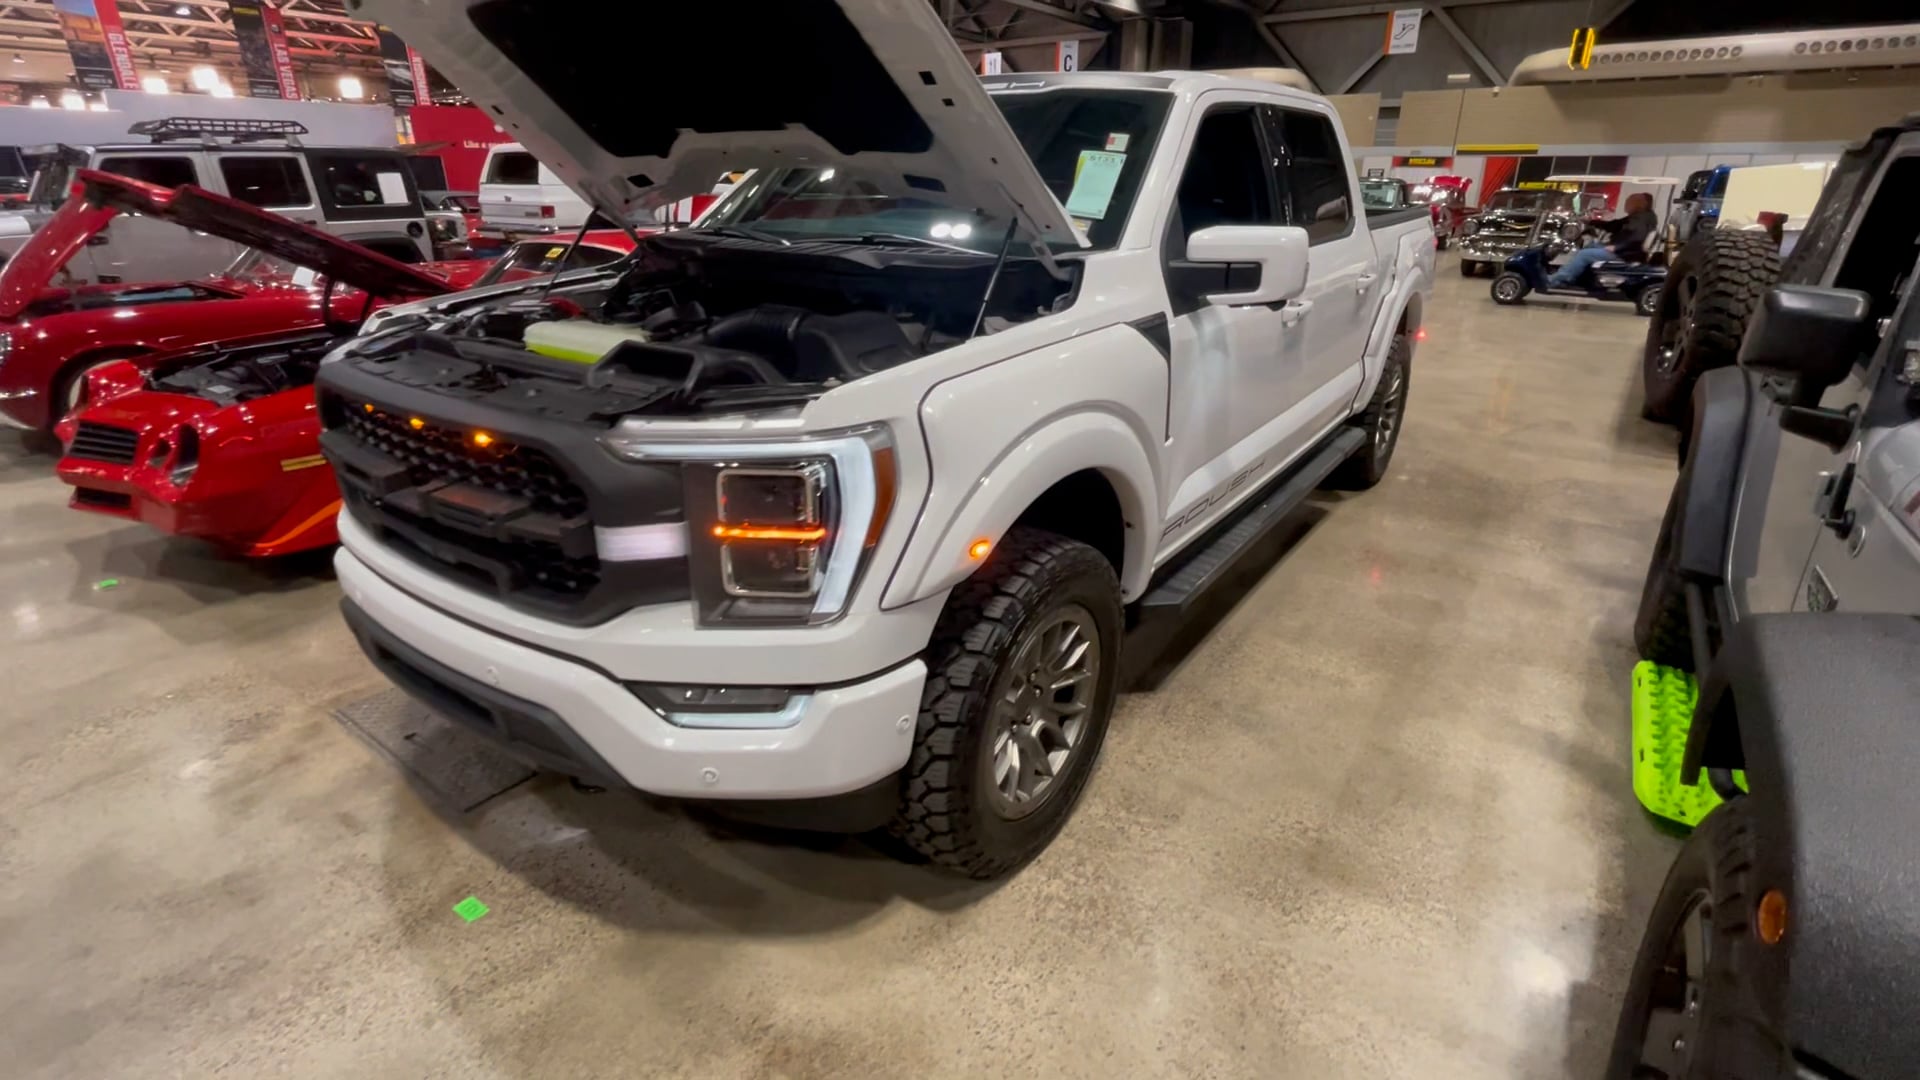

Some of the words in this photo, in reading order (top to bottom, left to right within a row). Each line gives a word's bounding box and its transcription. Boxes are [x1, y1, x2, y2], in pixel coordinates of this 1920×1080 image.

[107, 33, 139, 89] GLENDALE
[273, 43, 291, 63] LAS
[1063, 54, 1073, 72] C
[280, 65, 299, 99] VEGAS
[1160, 457, 1266, 542] ROUSH
